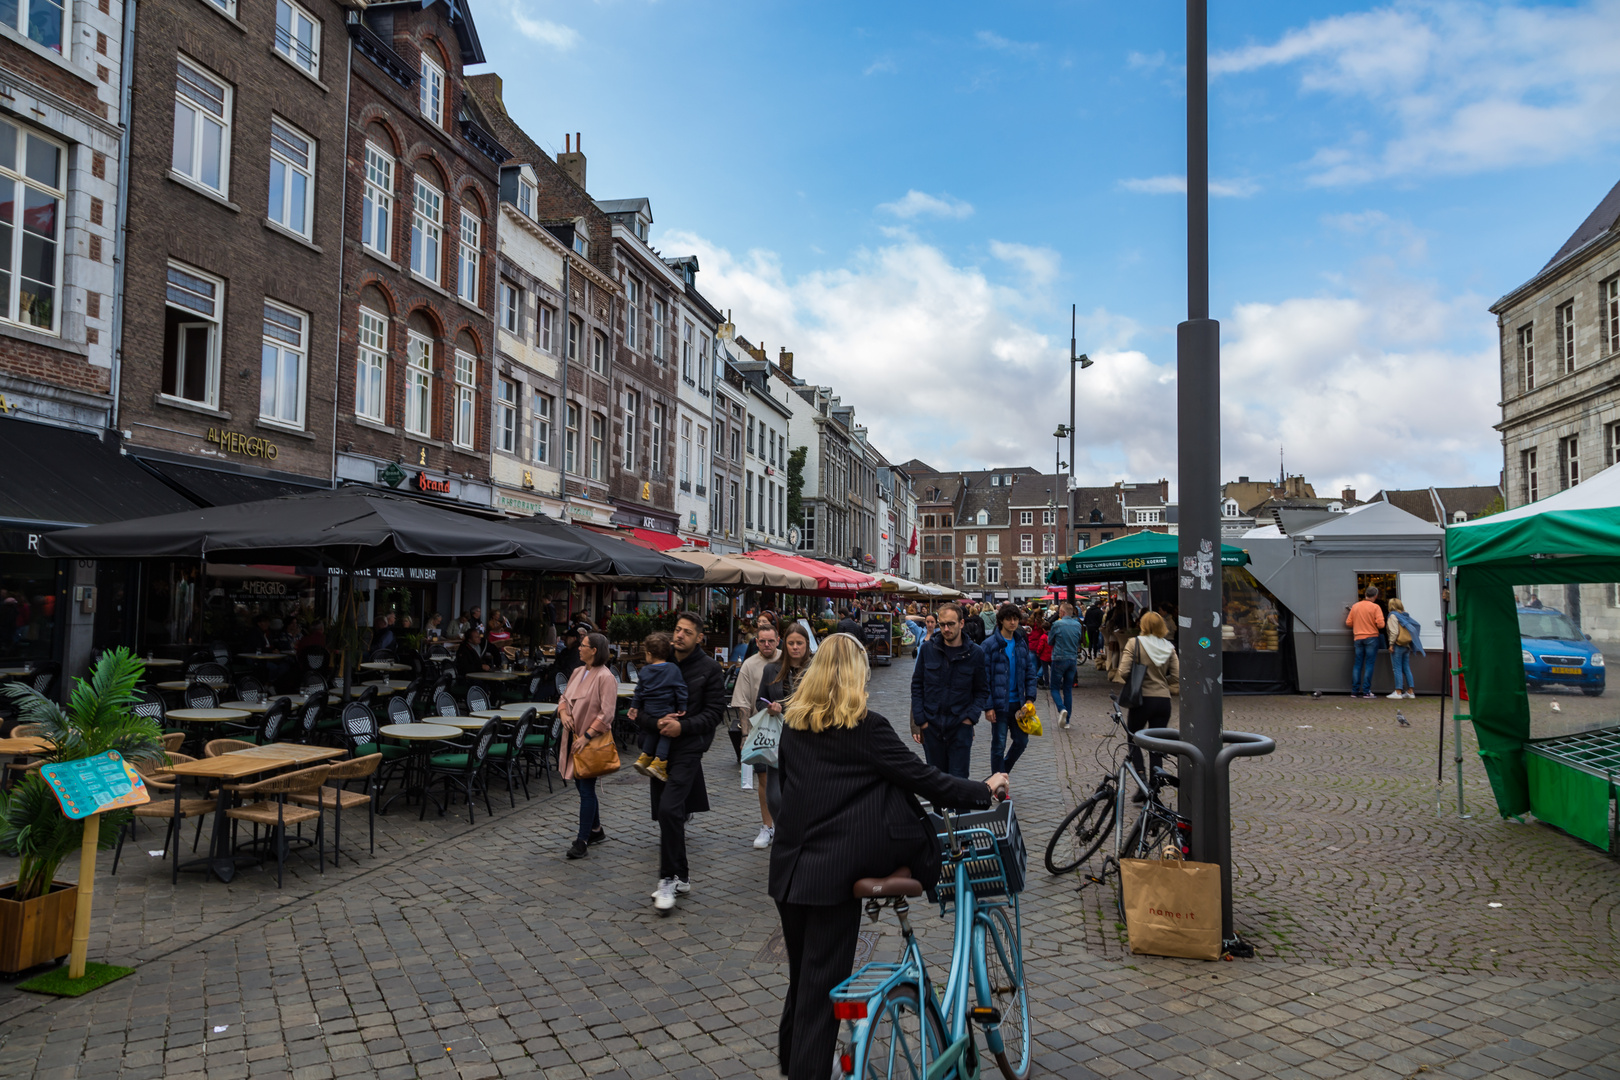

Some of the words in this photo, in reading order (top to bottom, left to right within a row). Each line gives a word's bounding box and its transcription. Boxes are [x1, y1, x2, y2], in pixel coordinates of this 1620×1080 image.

[207, 427, 220, 443] AL
[220, 429, 279, 461] MERCATO
[419, 471, 450, 494] Brand
[501, 496, 542, 513] RISTORANTE
[643, 516, 656, 529] KFC
[377, 567, 405, 579] PIZZERIA
[753, 731, 776, 748] Etos
[1149, 907, 1182, 919] name
[1185, 912, 1195, 920] it
